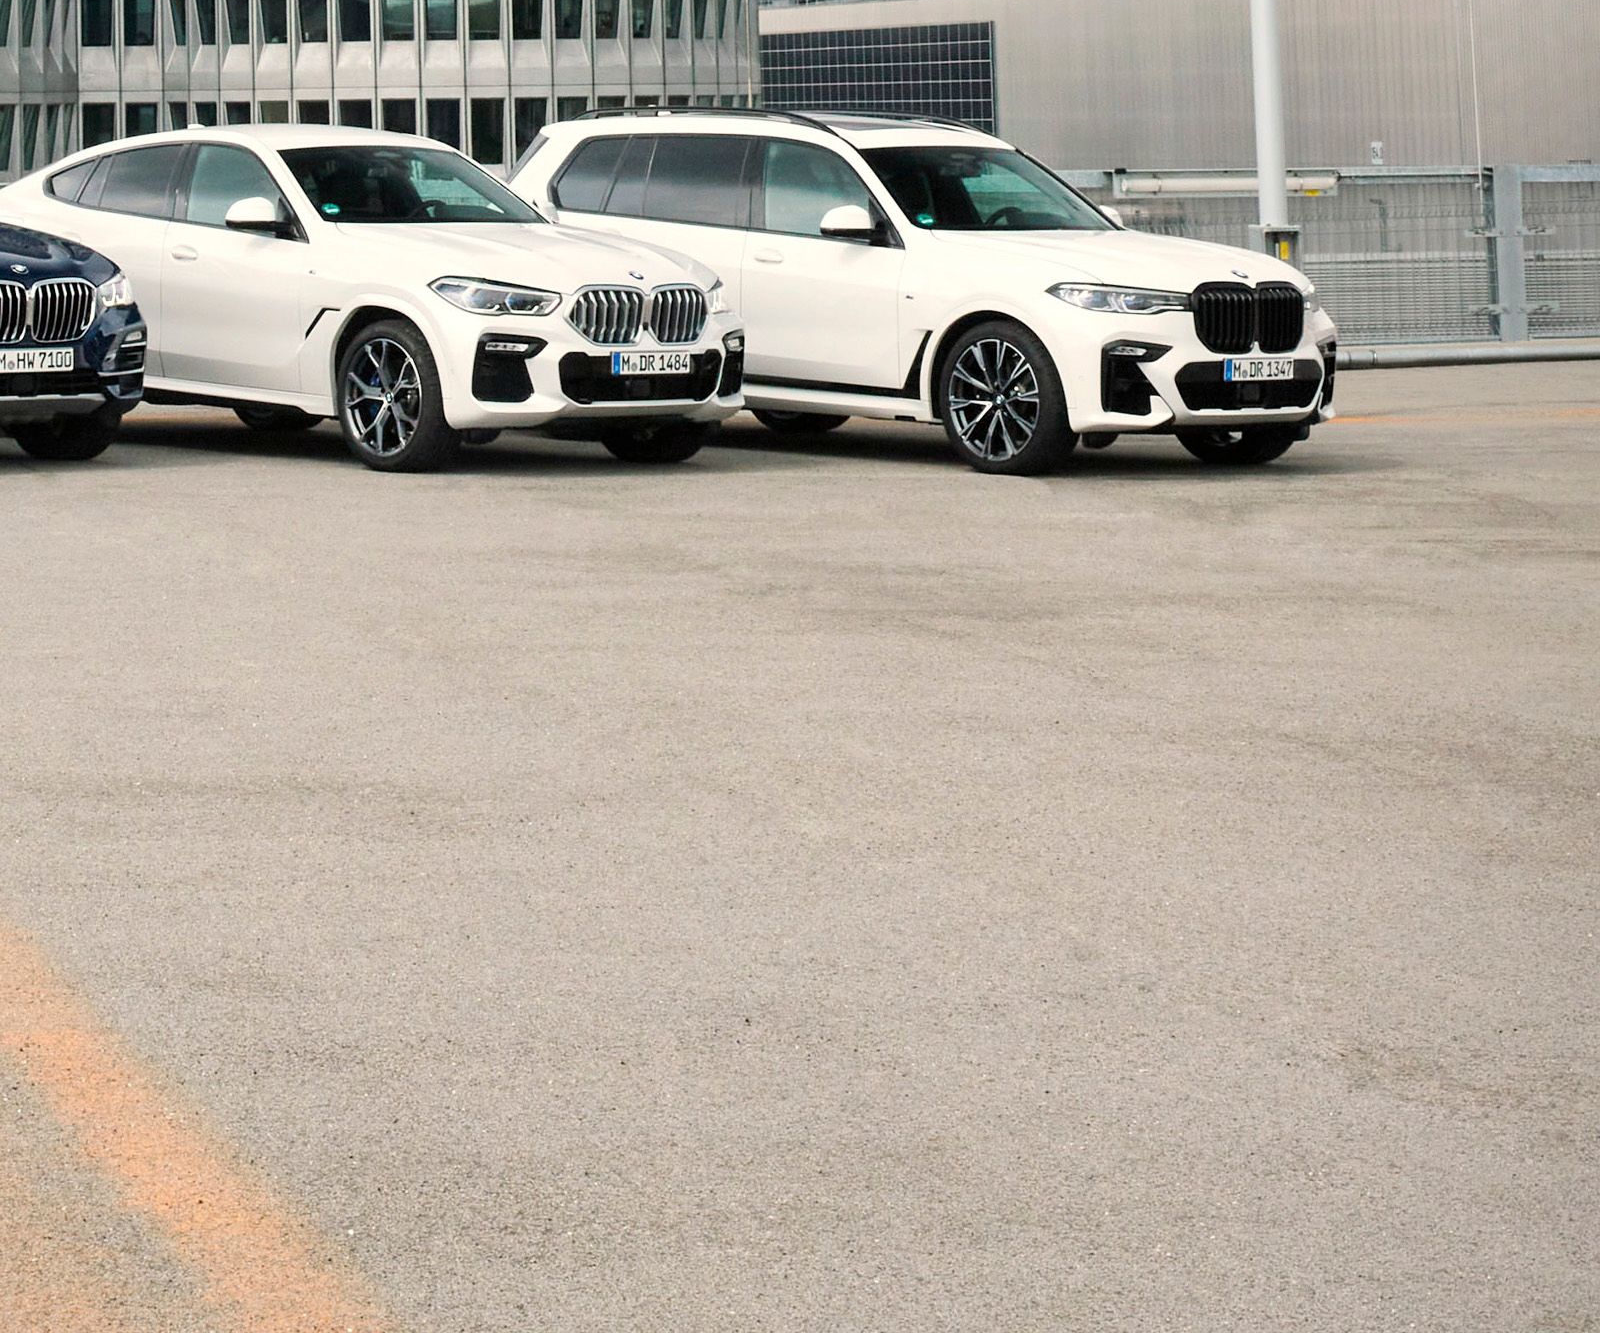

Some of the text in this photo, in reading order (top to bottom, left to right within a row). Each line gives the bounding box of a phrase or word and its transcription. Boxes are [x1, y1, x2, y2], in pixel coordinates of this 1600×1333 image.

[17, 352, 36, 369] HW
[39, 351, 72, 369] 7100
[622, 353, 689, 372] M DR 1484
[1233, 360, 1293, 378] M DR 1347
